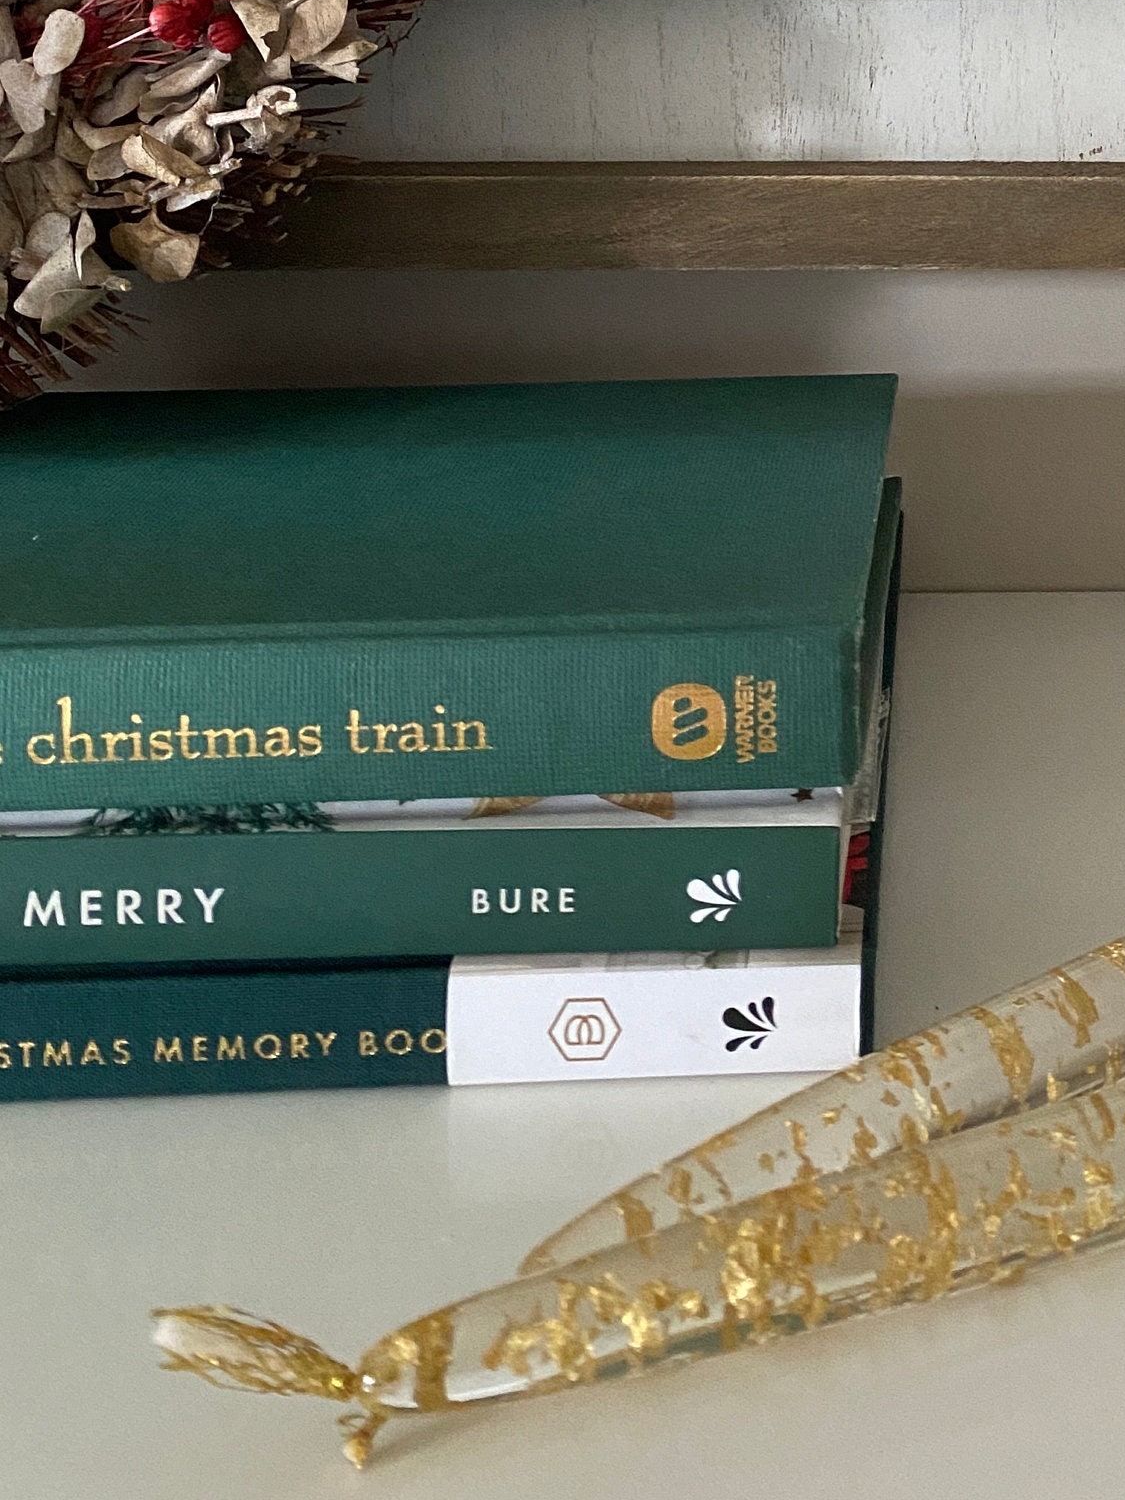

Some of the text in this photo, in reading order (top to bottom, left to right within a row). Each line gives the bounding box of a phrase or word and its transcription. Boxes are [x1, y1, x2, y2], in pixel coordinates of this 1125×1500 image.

[26, 695, 493, 766] christmas train
[735, 675, 755, 764] WARNER
[757, 680, 778, 753] BOOKS
[23, 887, 577, 927] MERRY BURE
[153, 1032, 338, 1062] MEMORY
